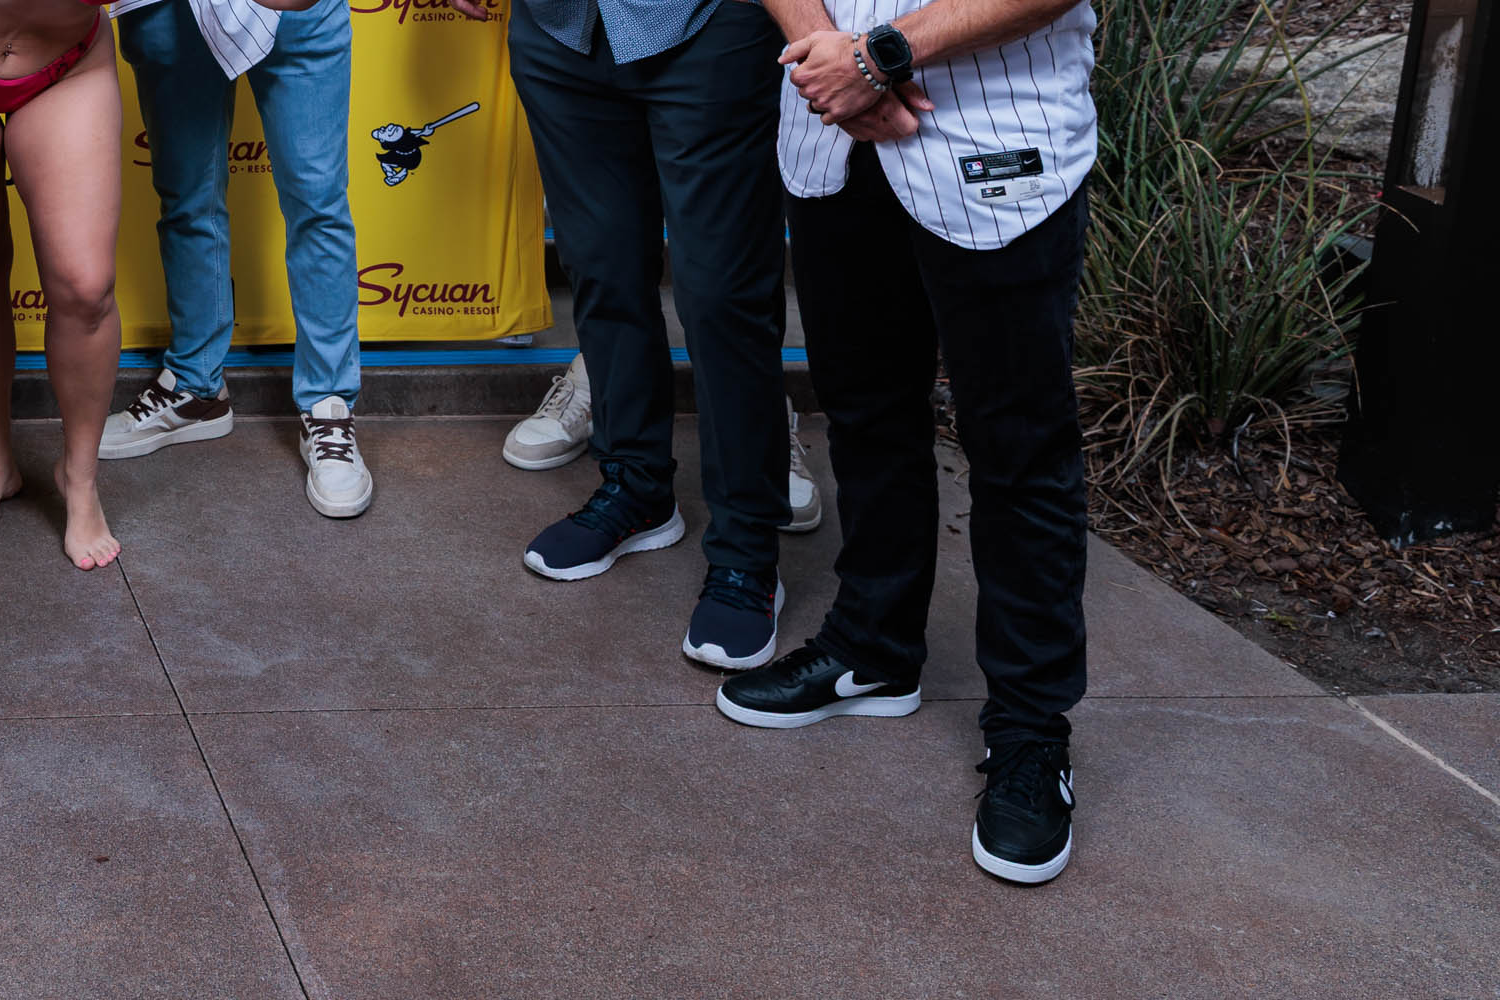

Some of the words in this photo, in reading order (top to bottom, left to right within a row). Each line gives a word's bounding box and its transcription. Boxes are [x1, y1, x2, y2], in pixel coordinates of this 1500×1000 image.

[412, 13, 455, 22] CASINO
[247, 164, 273, 174] RESO
[357, 262, 495, 318] Sycuan
[412, 306, 454, 316] CASINO
